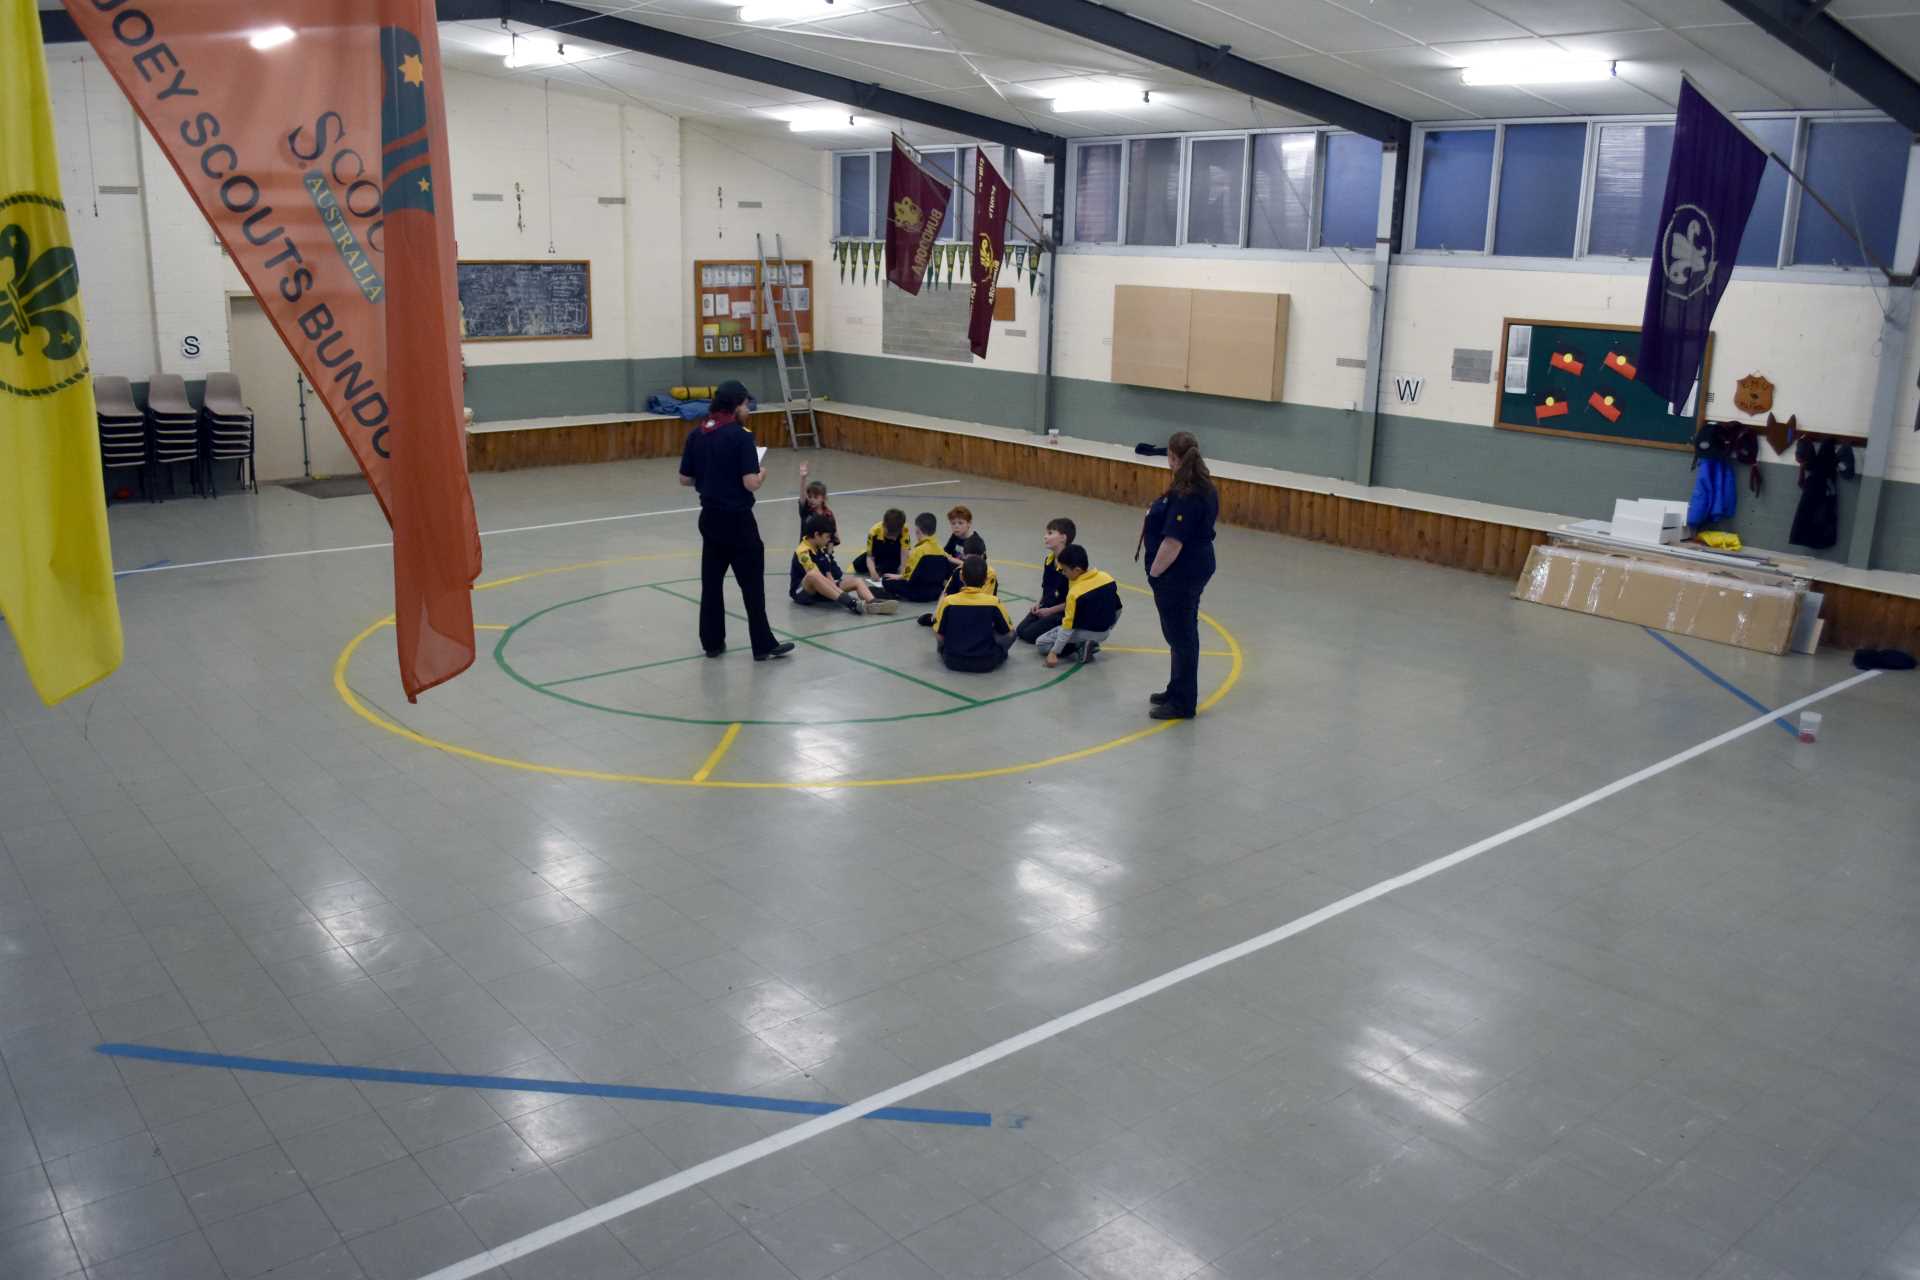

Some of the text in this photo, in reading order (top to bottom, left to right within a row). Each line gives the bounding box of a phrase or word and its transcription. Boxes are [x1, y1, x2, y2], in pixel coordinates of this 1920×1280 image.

[180, 112, 313, 302] SCOUTS
[306, 177, 384, 301] AUSTRALIA
[184, 335, 200, 355] S
[1396, 379, 1420, 402] W
